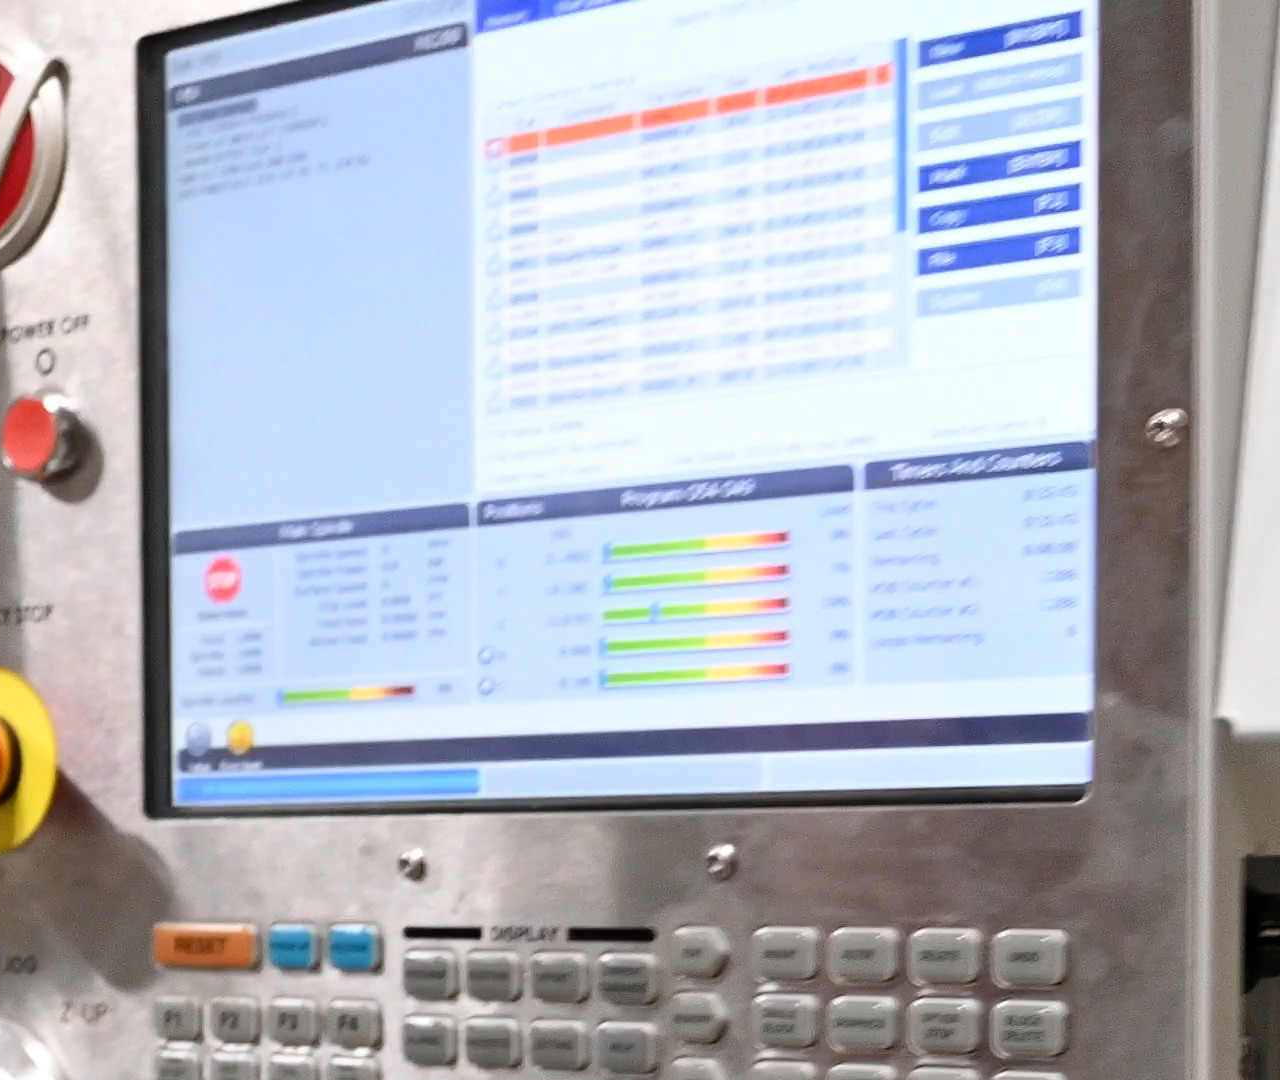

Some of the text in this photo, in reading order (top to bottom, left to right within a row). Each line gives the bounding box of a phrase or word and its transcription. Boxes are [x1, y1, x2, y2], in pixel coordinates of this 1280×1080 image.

[0, 314, 92, 345] POWER OFF
[15, 604, 56, 625] STOP
[491, 926, 558, 942] DISPLAY
[5, 955, 38, 975] JOG
[221, 1011, 238, 1029] F2
